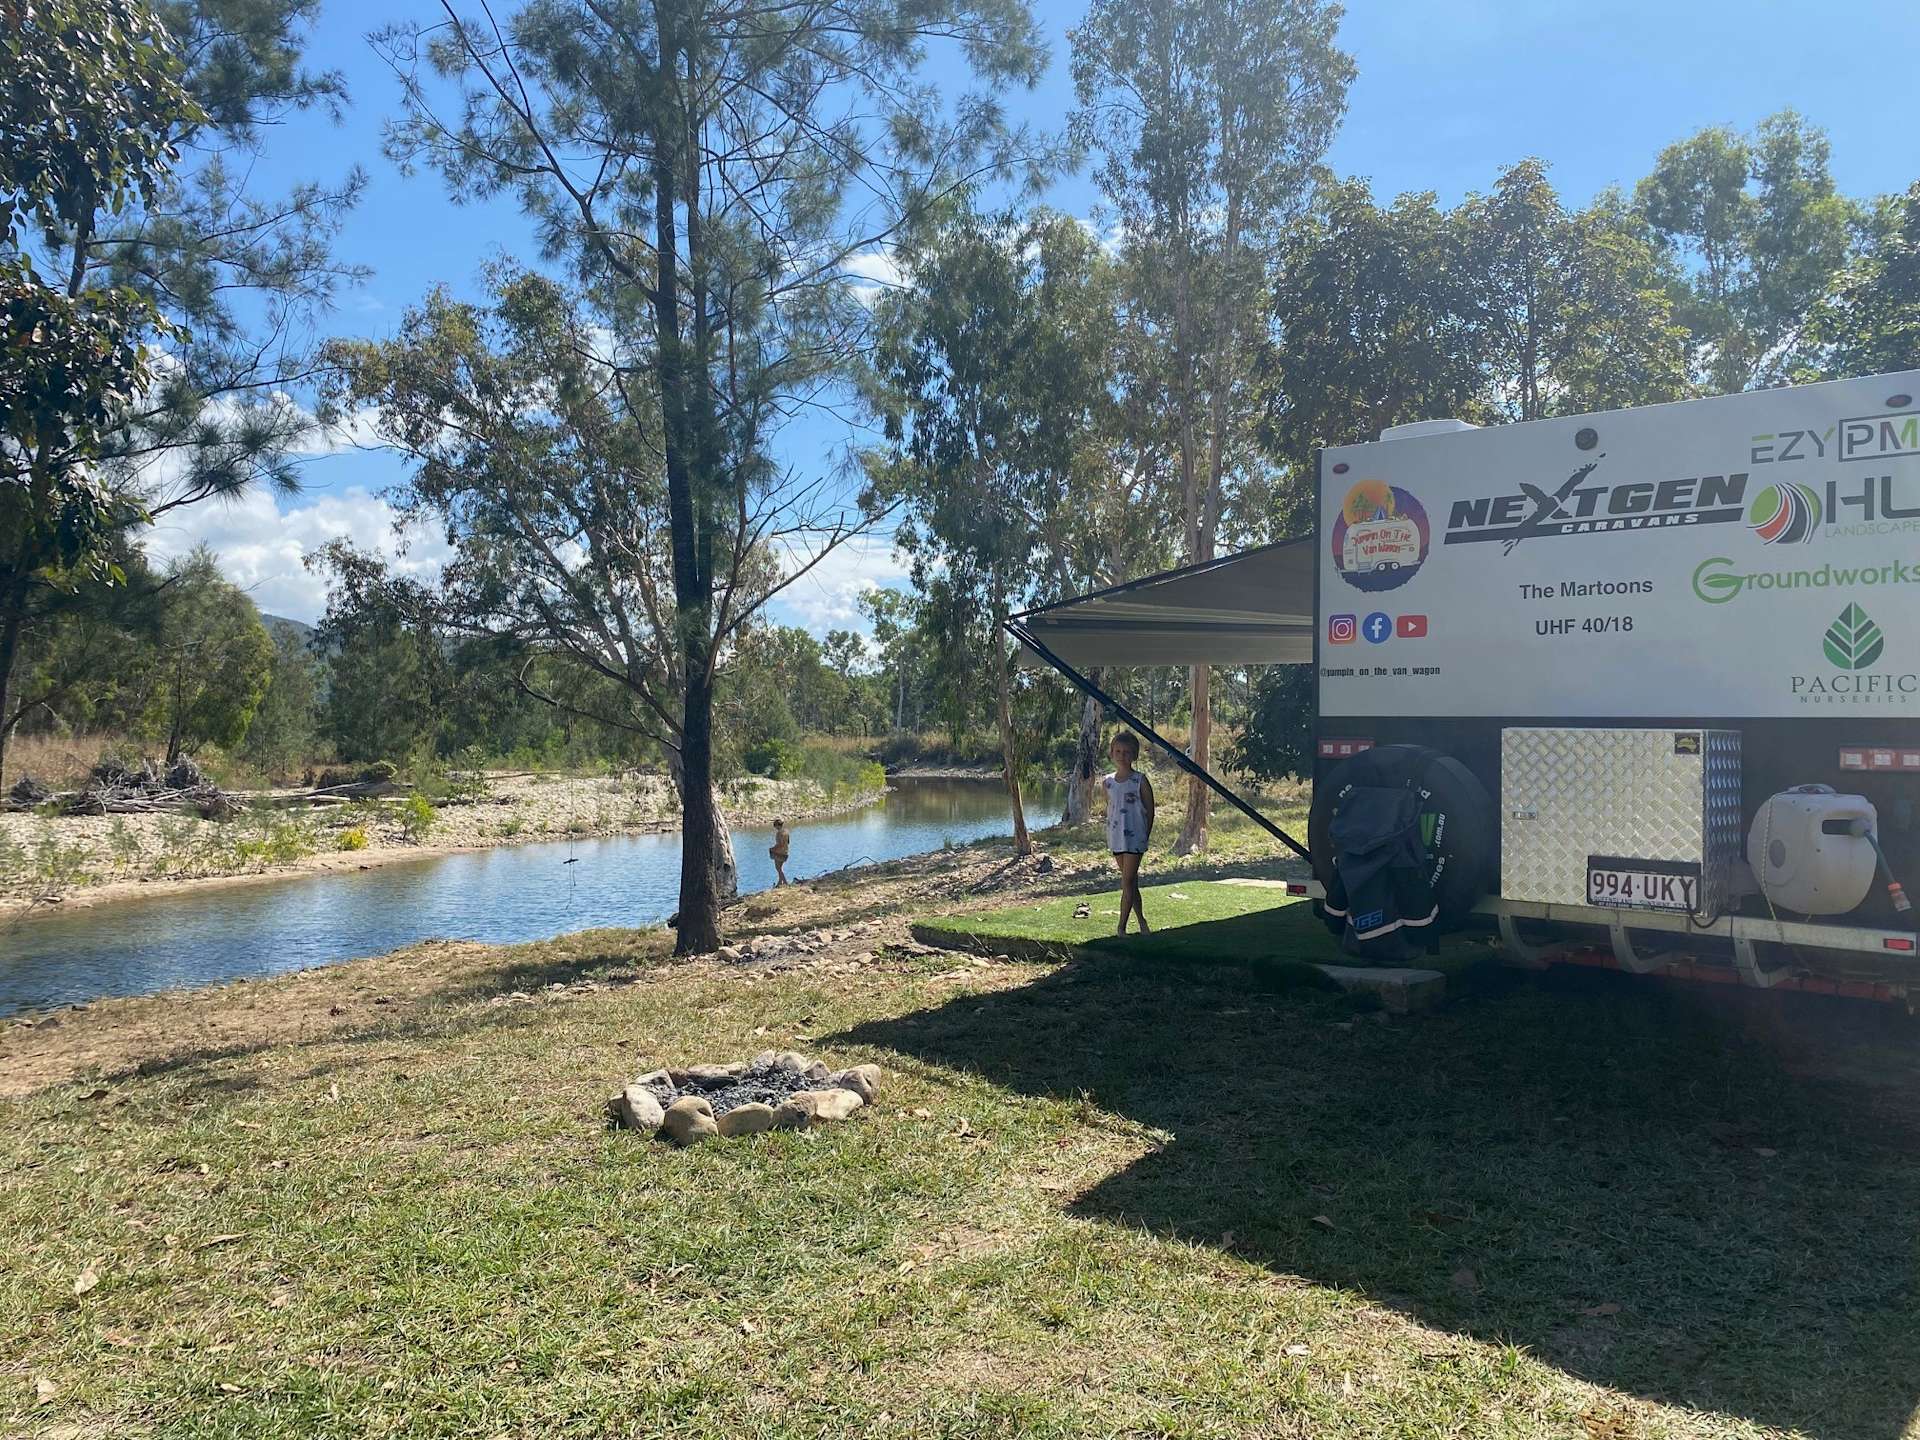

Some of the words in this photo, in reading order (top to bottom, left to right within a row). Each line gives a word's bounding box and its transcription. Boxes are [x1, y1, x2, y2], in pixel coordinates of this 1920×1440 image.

[1751, 426, 1836, 464] EZY
[1848, 418, 1918, 455] PM
[1447, 462, 1749, 535] NEXTGEN
[1561, 513, 1699, 535] CARAVANS
[1519, 583, 1555, 600] The
[1560, 579, 1653, 598] Martoons
[1692, 557, 1920, 604] Groundworks
[1535, 618, 1576, 636] UHF
[1581, 616, 1634, 634] 40/18
[1791, 674, 1918, 694] PACIFIC
[1800, 695, 1907, 704] NURSERIES
